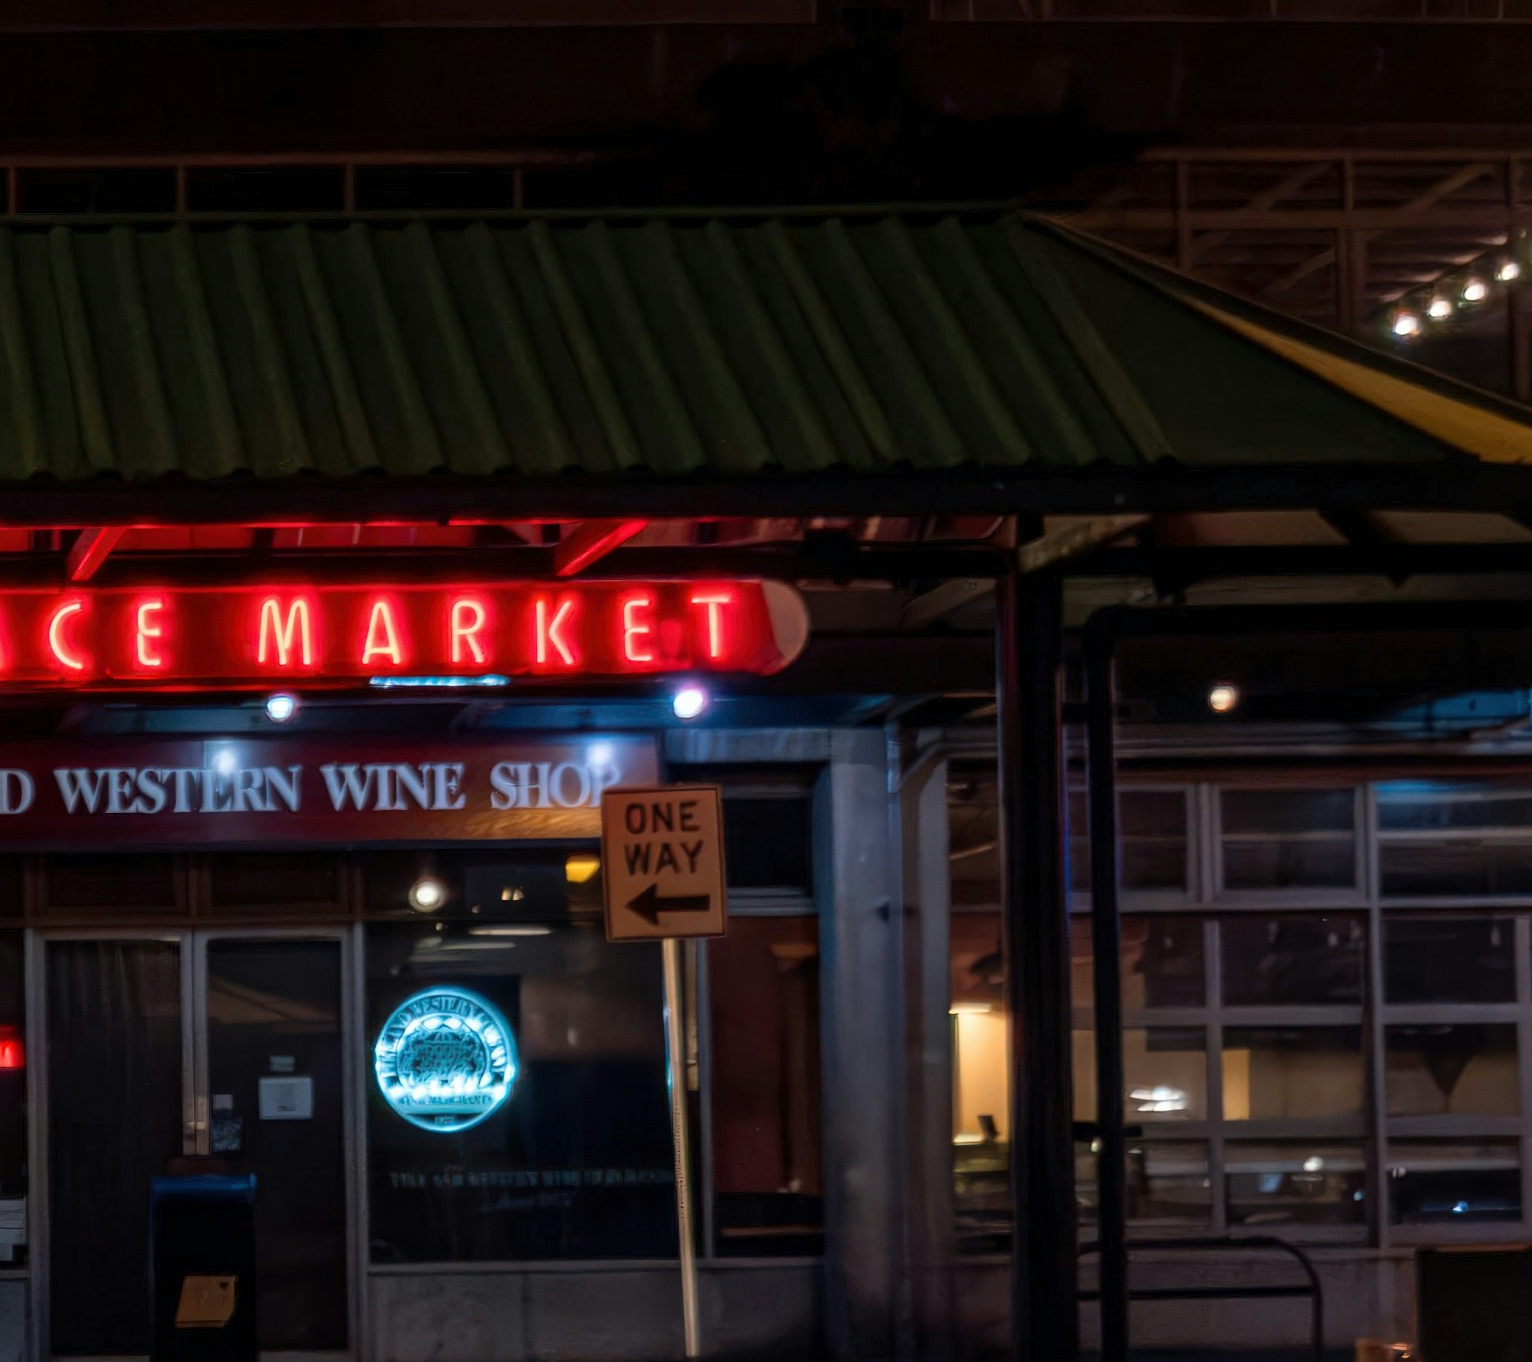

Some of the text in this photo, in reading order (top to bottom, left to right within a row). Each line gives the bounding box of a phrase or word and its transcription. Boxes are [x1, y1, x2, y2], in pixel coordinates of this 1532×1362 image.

[256, 595, 733, 666] MARKET
[53, 764, 301, 815] WESTERN
[320, 761, 467, 812] WINE
[489, 759, 622, 810] SHOP
[624, 801, 701, 835] ONE
[623, 841, 704, 877] WAY
